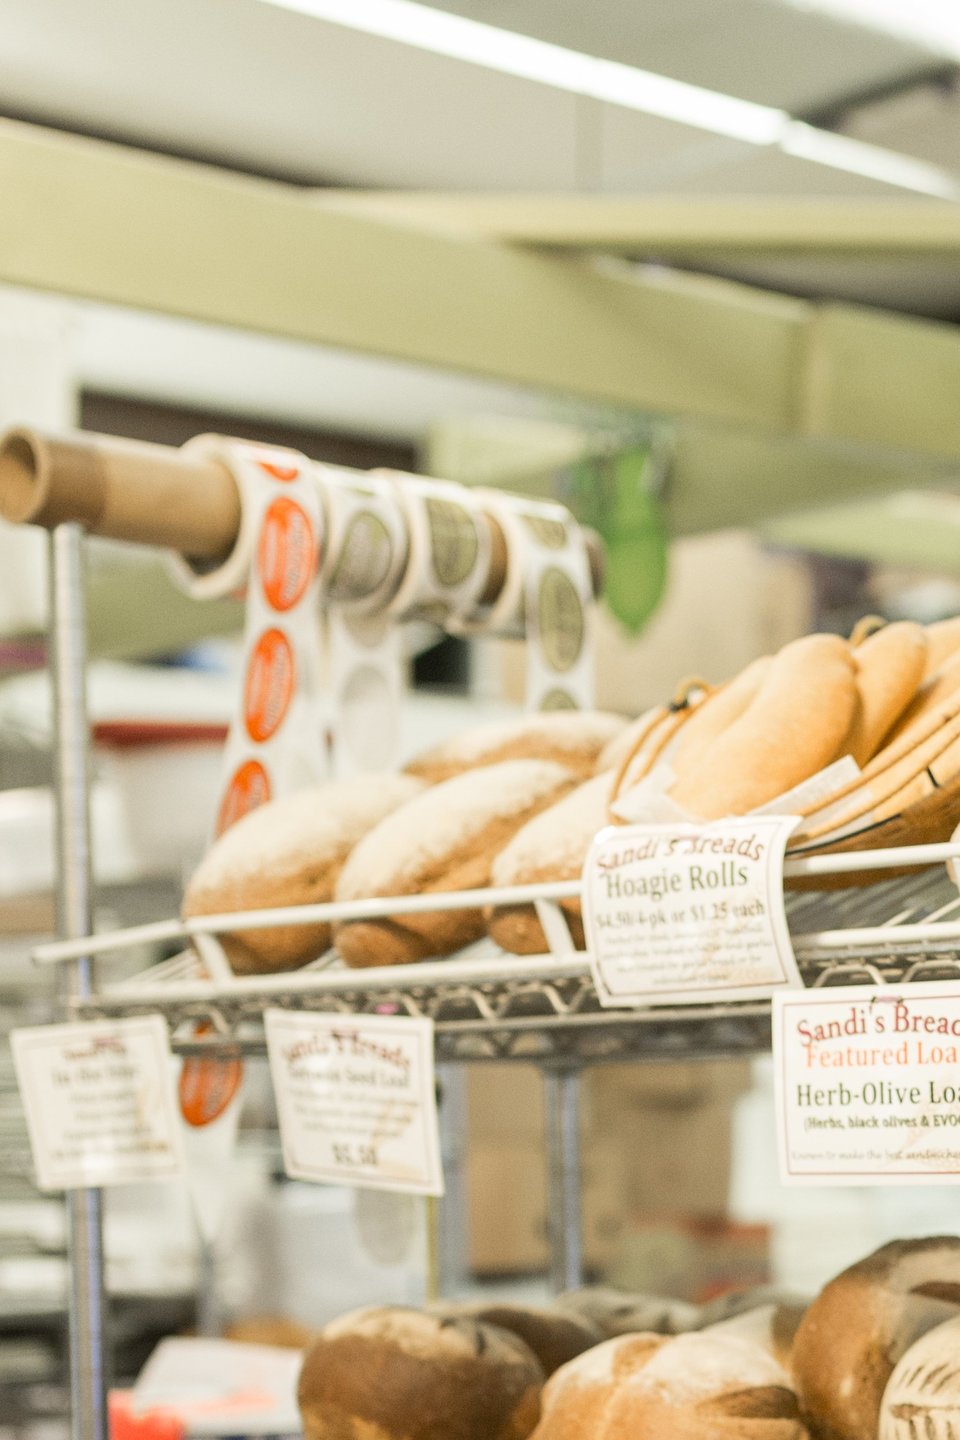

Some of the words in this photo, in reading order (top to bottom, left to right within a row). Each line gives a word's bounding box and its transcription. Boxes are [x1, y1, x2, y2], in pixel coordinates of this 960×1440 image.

[604, 868, 682, 902] Hoagie
[689, 861, 748, 891] Rolls
[733, 899, 765, 917] each
[797, 1006, 885, 1047] Sandi's
[806, 1041, 908, 1069] Featured
[797, 1081, 920, 1107] Herb-Olive
[804, 1117, 845, 1132] (Herbs,
[848, 1115, 878, 1128] black
[883, 1114, 917, 1128] olives
[920, 1114, 929, 1127] &
